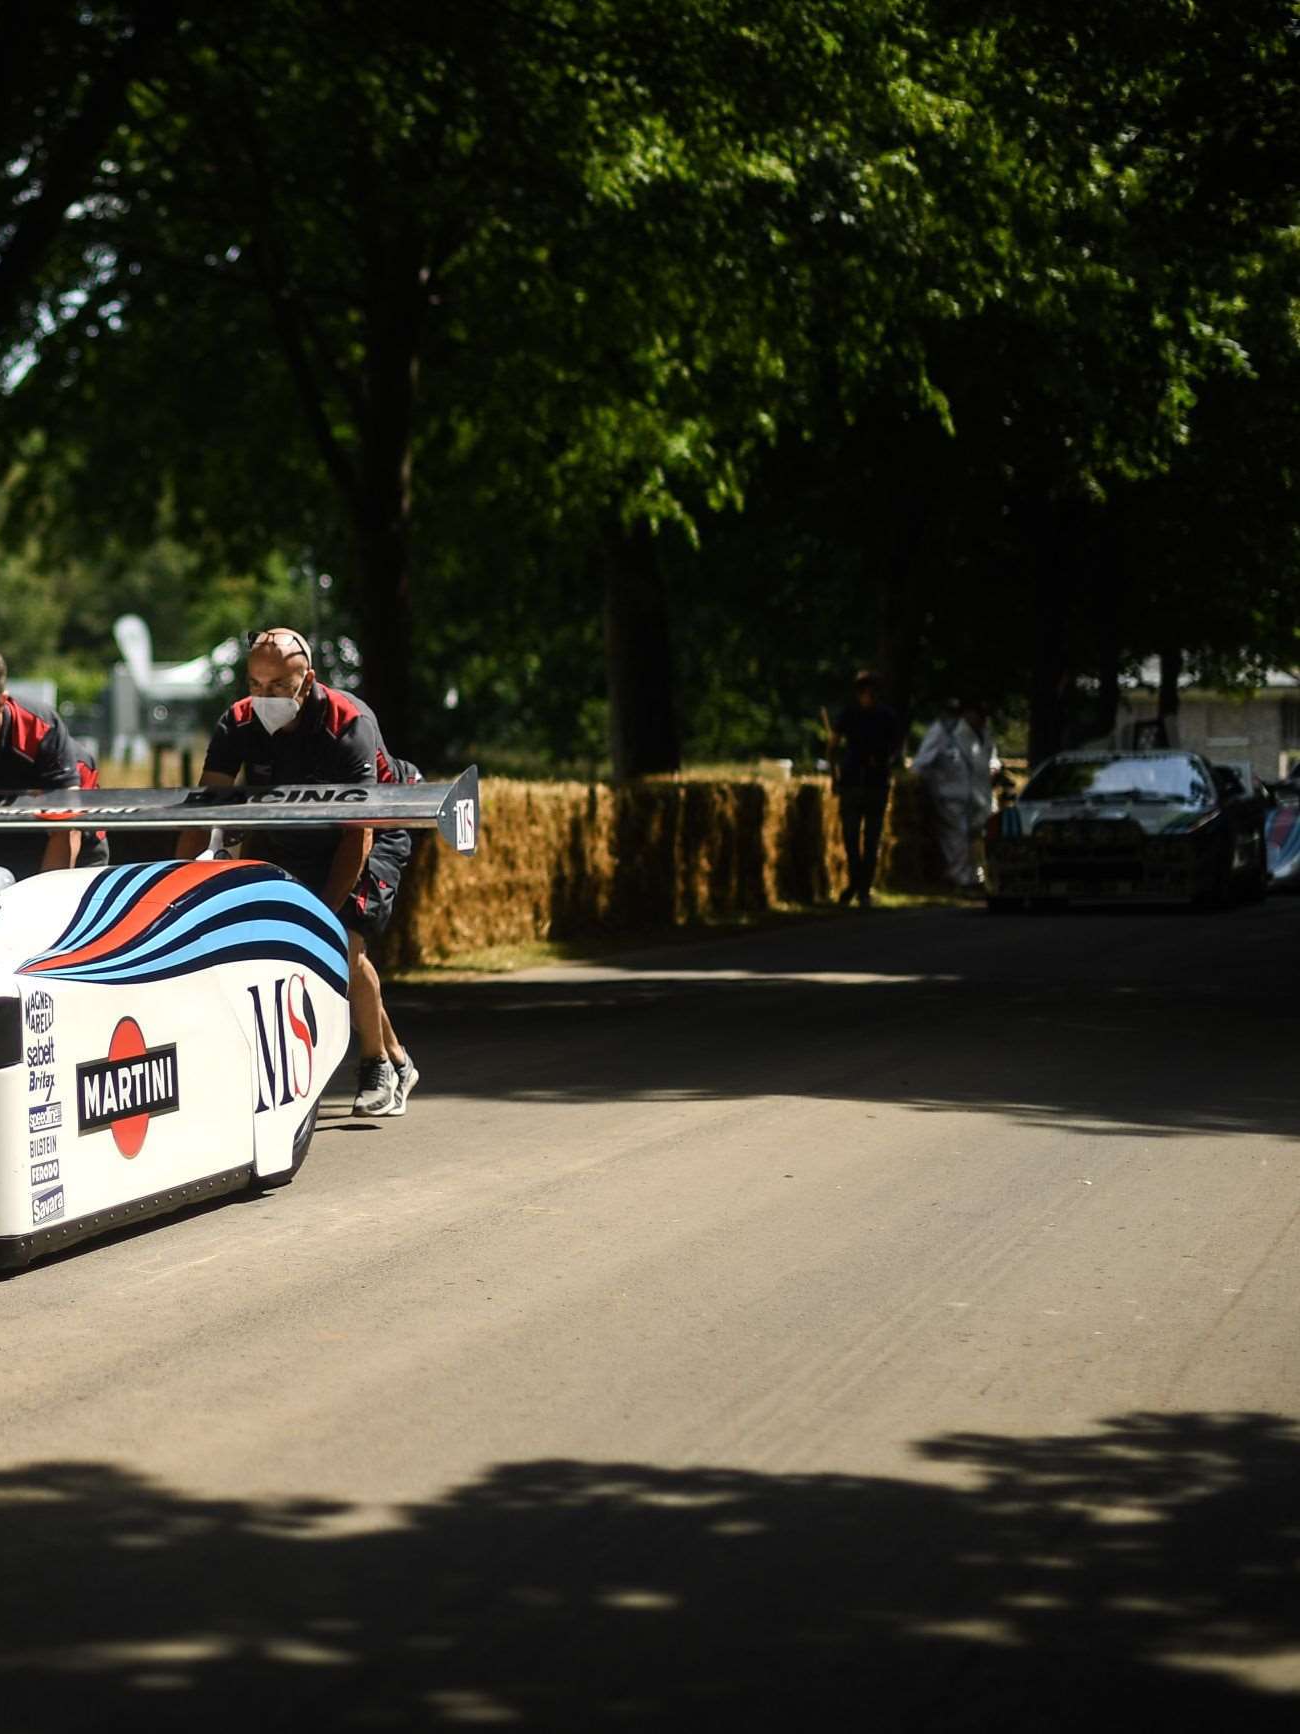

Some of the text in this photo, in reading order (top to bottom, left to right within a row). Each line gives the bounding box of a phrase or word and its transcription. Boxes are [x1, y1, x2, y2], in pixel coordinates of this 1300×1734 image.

[183, 788, 368, 804] RCING
[26, 1035, 55, 1068] sabelt
[246, 972, 317, 1114] MS
[28, 1070, 55, 1102] Britax
[83, 1056, 173, 1120] MARTINI
[29, 1135, 57, 1159] BILSTEIN
[31, 1161, 59, 1183] FERODO
[32, 1191, 64, 1223] Savara
